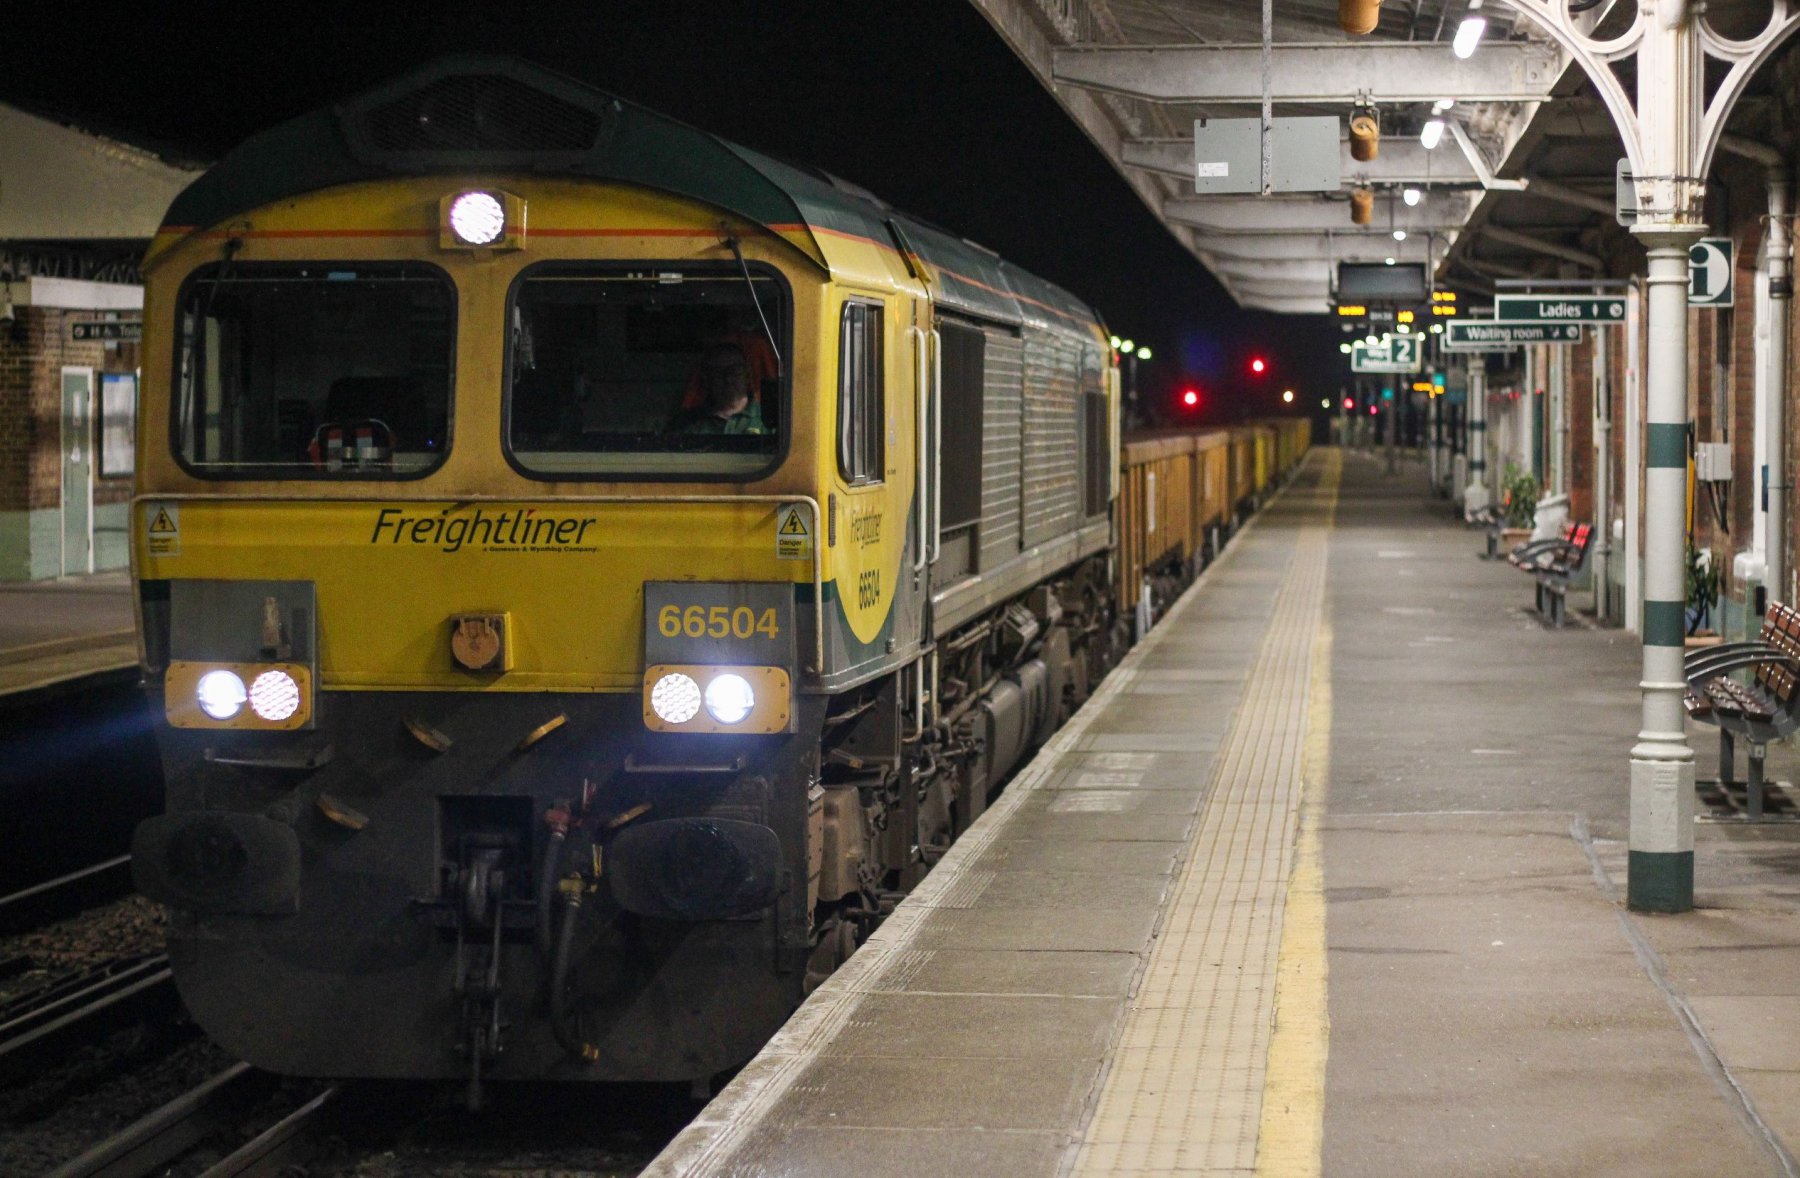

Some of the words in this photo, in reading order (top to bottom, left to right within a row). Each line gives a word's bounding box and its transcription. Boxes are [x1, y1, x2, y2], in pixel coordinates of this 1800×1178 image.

[1539, 303, 1581, 317] Ladies
[1466, 327, 1511, 342] Waiting
[1513, 328, 1543, 339] room
[1396, 340, 1411, 362] 2
[371, 509, 597, 552] Freightliner
[859, 569, 880, 610] 66504
[658, 604, 779, 640] 66504
